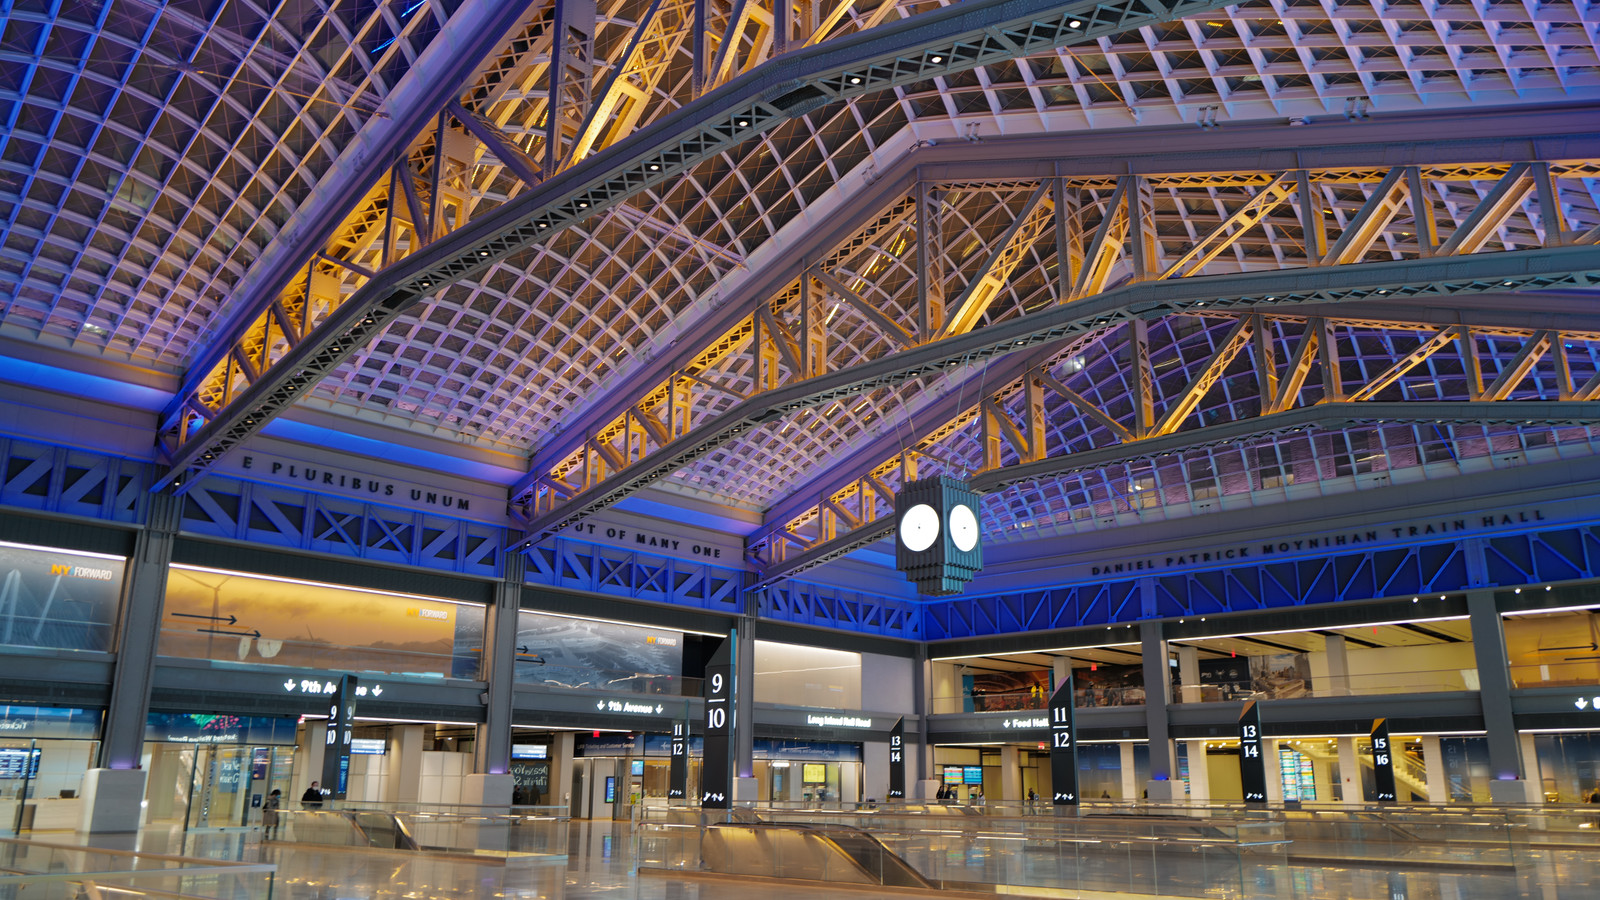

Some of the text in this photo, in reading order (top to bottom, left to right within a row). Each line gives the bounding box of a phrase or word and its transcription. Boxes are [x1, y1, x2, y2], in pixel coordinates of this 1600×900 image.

[242, 456, 470, 511] E PLURIBUS UNUM
[575, 523, 721, 558] UT OF MANY ONE
[1092, 510, 1544, 576] DANIEL PATRICK MOYNIHAN TRAIN HALL
[51, 564, 112, 580] NY FORWARD
[407, 608, 447, 619] NY FORWARD
[647, 636, 676, 646] NY FORWARD
[301, 680, 321, 693] 9th
[712, 673, 723, 693] 9
[330, 705, 337, 720] 9
[347, 706, 353, 720] 9
[608, 701, 653, 713] 9th Avenue
[708, 708, 725, 729] 10
[808, 715, 824, 726] Long
[1053, 707, 1067, 722] 11
[674, 724, 682, 736] 11
[1013, 719, 1031, 728] Food
[327, 730, 336, 744] 10
[343, 730, 351, 744] 10
[1243, 725, 1257, 738] 13
[891, 736, 900, 746] 13
[1053, 732, 1070, 748] 12
[1374, 738, 1386, 749] 15
[673, 743, 683, 755] 12
[1244, 745, 1259, 758] 14
[891, 751, 901, 762] 14
[1376, 754, 1389, 765] 16
